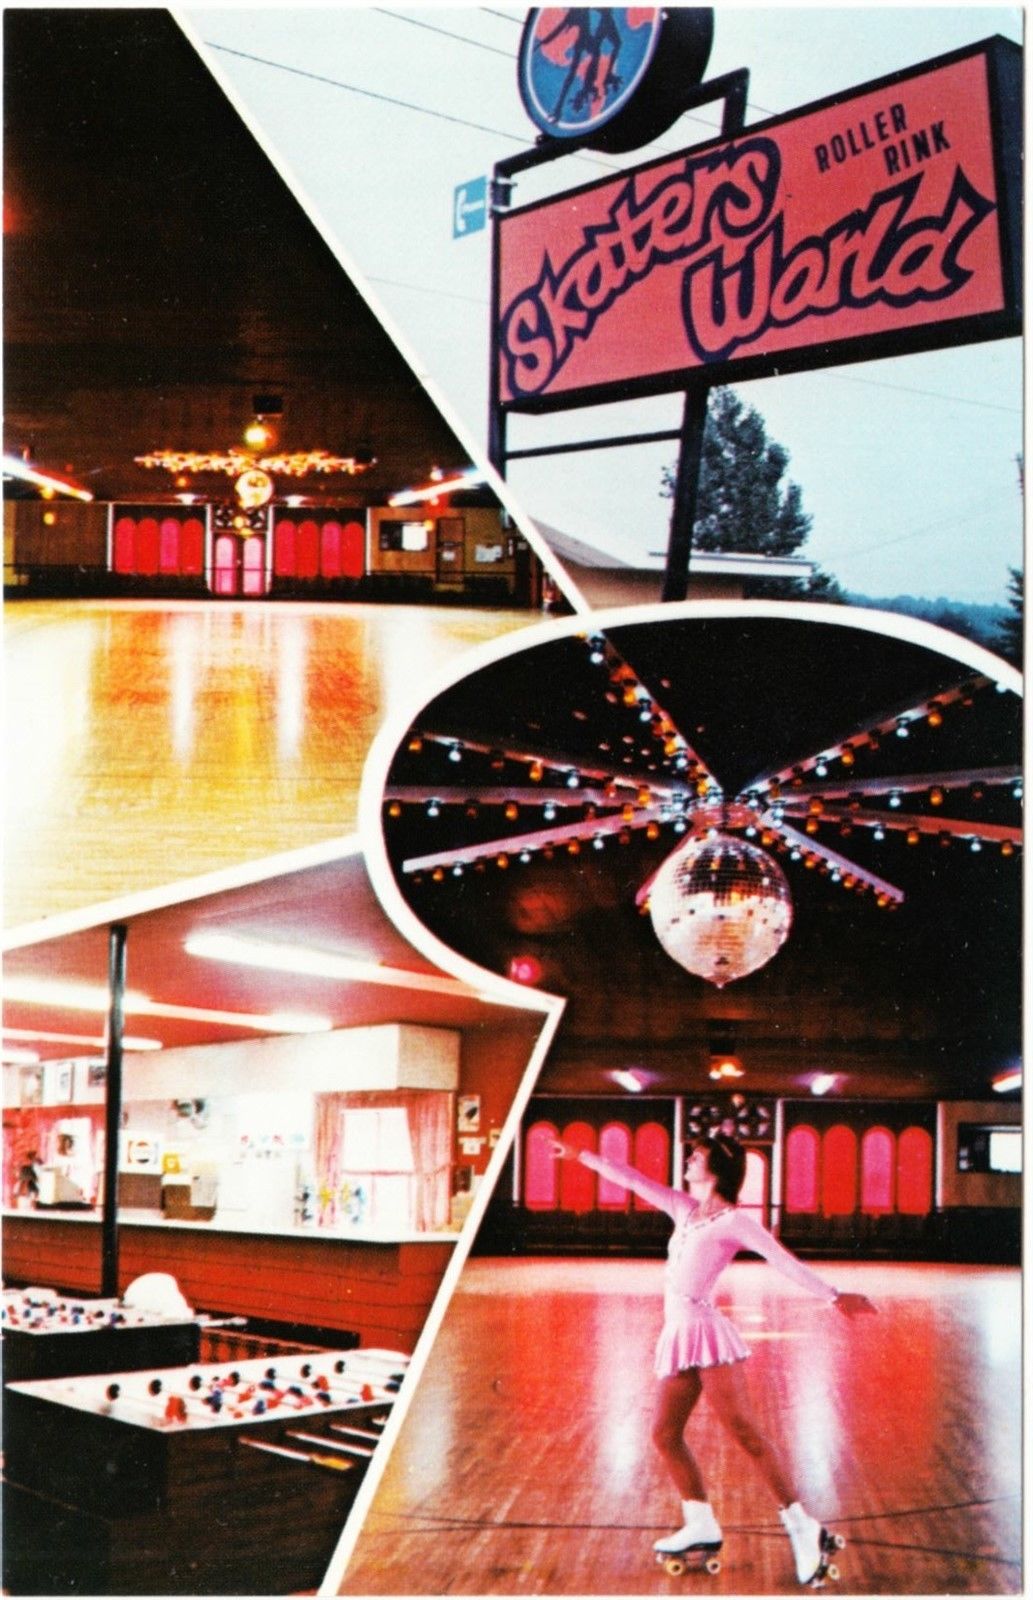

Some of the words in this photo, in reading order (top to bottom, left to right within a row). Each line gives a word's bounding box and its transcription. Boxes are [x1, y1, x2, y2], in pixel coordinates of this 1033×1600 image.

[814, 102, 908, 174] ROLLER
[882, 119, 952, 177] RINK
[501, 138, 780, 398] Skaters
[682, 164, 996, 362] World
